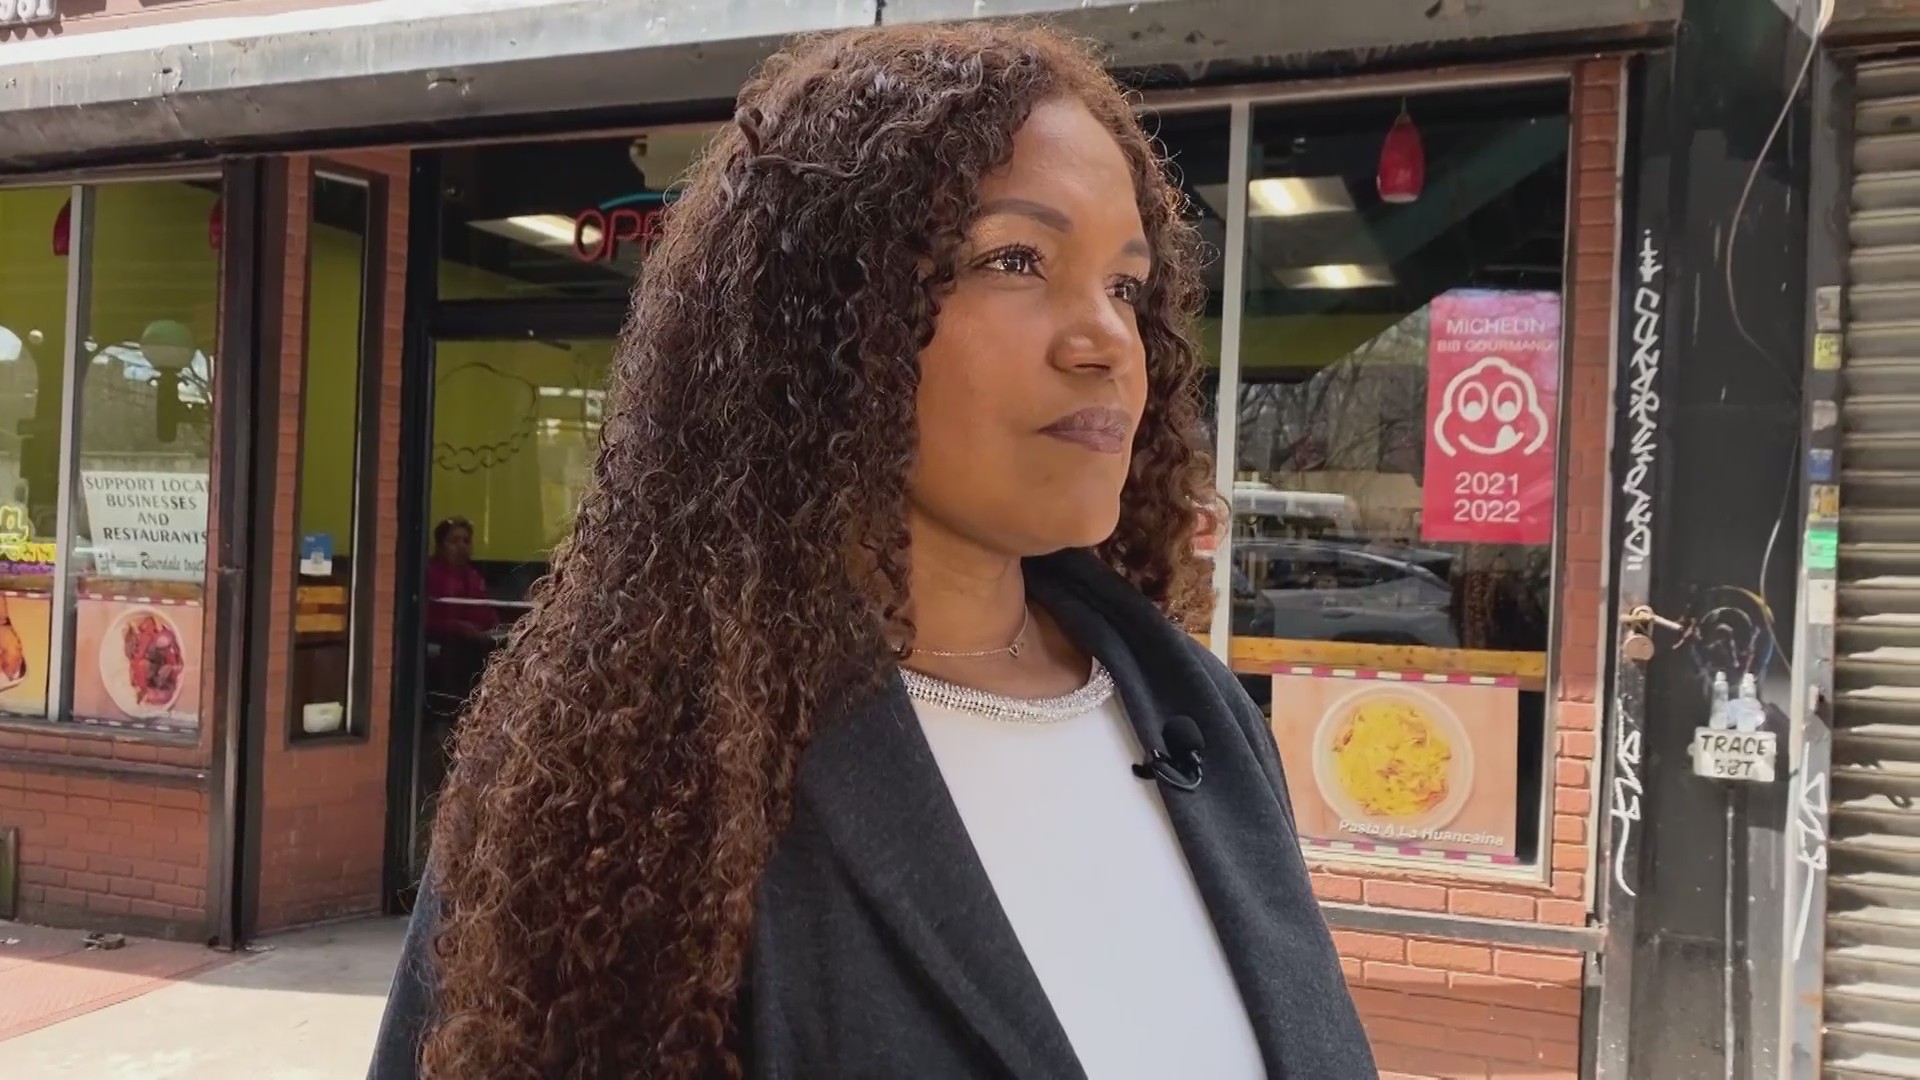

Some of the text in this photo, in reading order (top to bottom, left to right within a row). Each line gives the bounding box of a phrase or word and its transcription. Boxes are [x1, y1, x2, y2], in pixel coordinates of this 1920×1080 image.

[575, 209, 666, 261] OPE
[1446, 319, 1546, 335] MICHELIN
[1437, 340, 1460, 353] BIB
[86, 477, 208, 493] SUPPORT LOCA
[1454, 471, 1519, 495] 2021
[106, 493, 197, 510] BUSINESSES
[138, 512, 169, 526] AND
[1454, 499, 1520, 523] 2022
[1700, 735, 1768, 755] TRACE
[1339, 819, 1380, 835] Pasta
